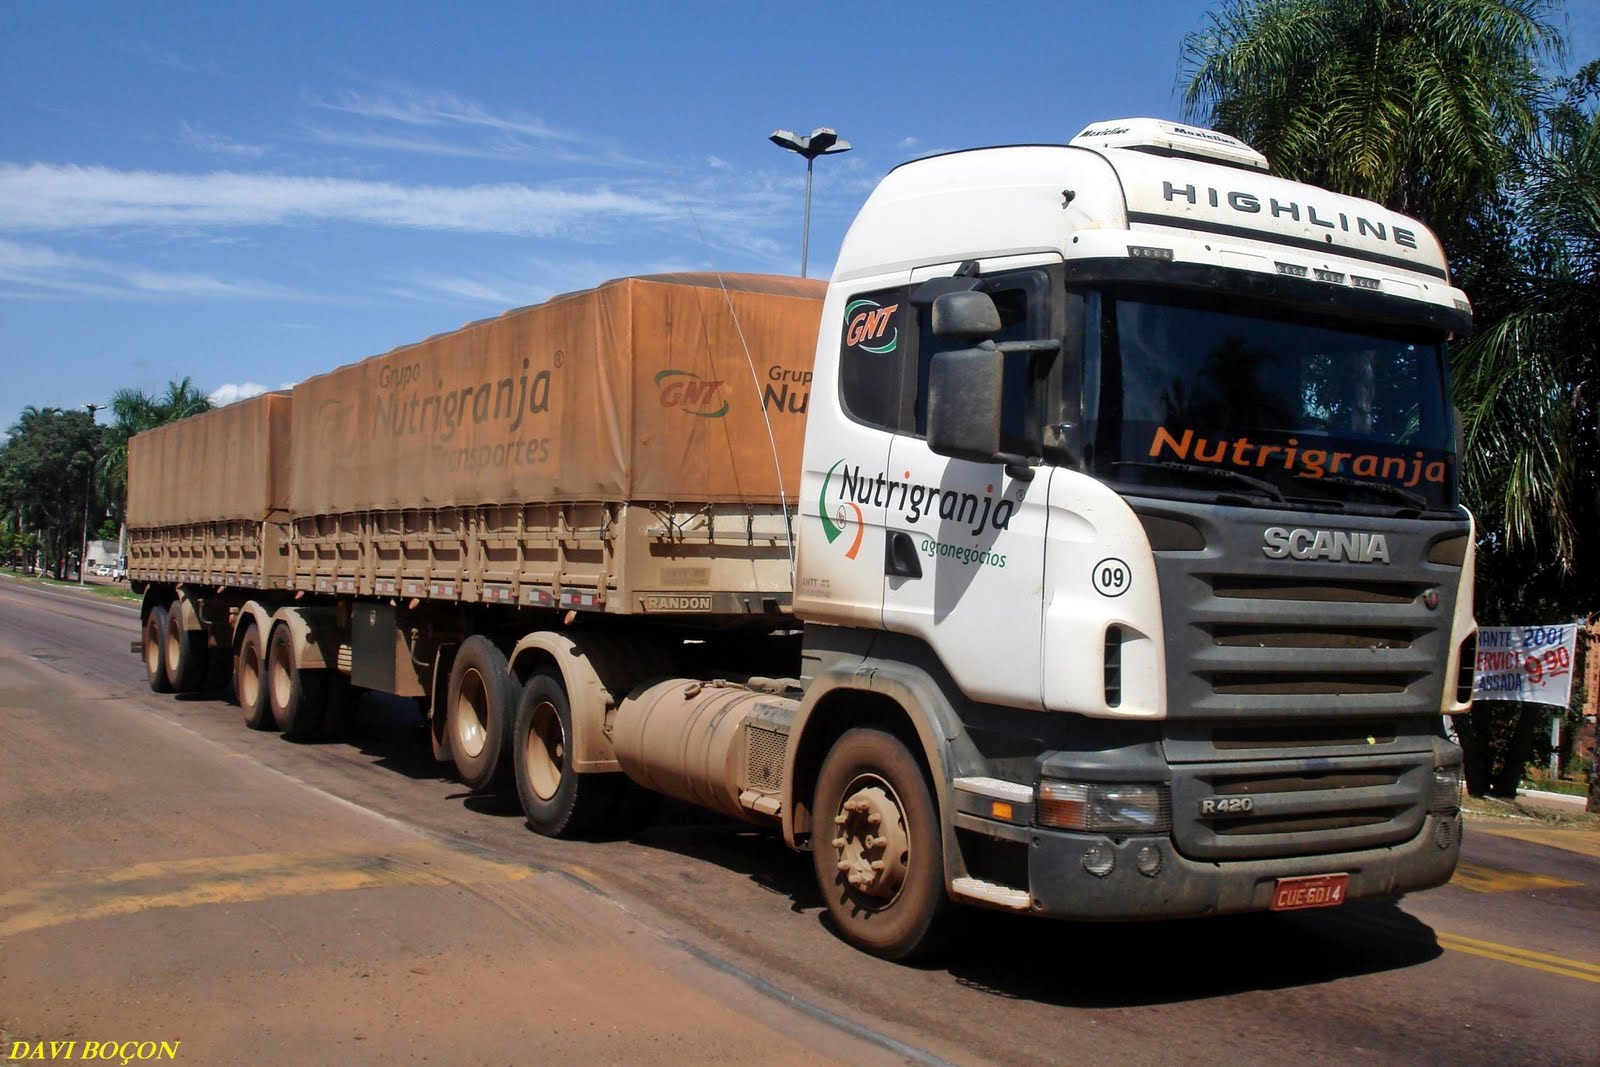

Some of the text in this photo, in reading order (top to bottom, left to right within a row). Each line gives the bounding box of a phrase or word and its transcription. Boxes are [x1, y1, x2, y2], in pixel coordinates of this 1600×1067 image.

[1163, 181, 1417, 249] HIGHLINE
[847, 304, 898, 347] GNT
[379, 362, 420, 391] Grupo
[372, 358, 551, 443] Nutrigranja
[660, 380, 724, 408] GNT
[761, 383, 809, 414] Nu
[1149, 426, 1447, 488] Nutrigranja
[839, 464, 1014, 536] Nutrigranja
[921, 539, 1007, 567] agronegócios
[1262, 526, 1390, 564] SCANIA
[1102, 567, 1124, 588] 09
[647, 597, 710, 610] RANDON
